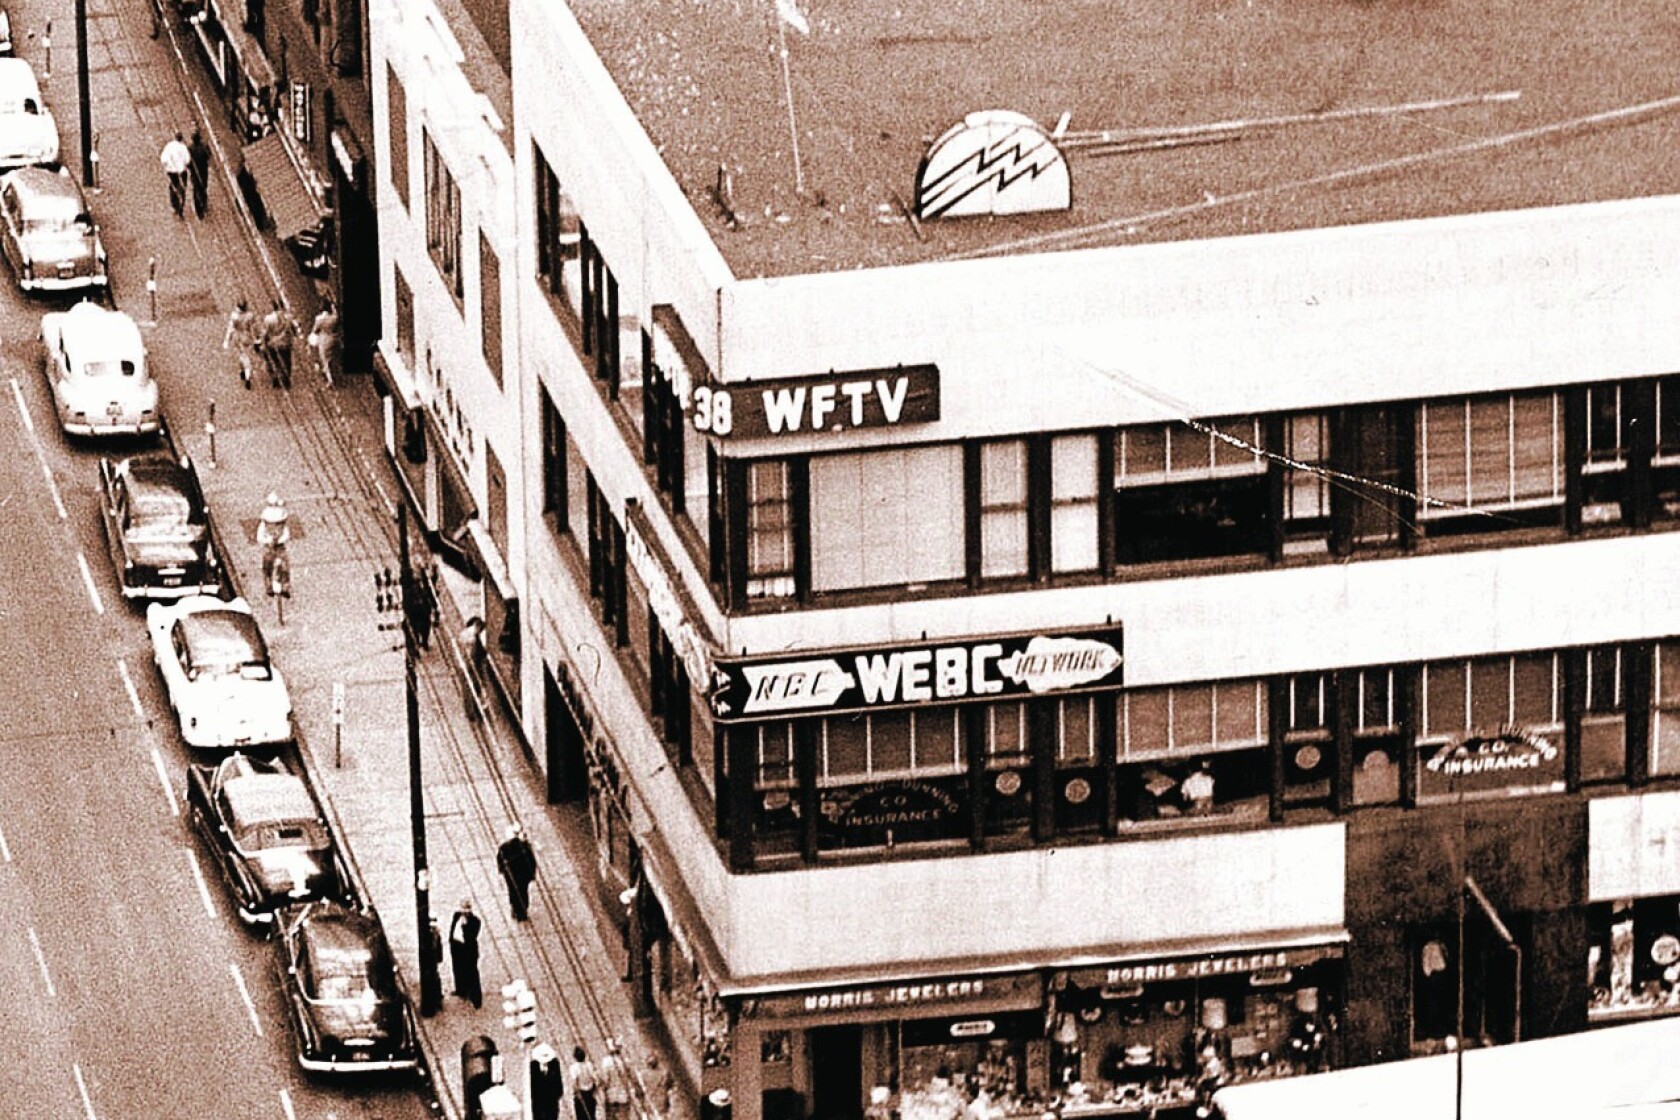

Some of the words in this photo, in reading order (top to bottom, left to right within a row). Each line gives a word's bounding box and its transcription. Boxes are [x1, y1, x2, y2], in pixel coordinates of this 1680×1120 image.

[693, 386, 732, 435] 38
[762, 377, 909, 434] WFTV
[755, 668, 834, 701] NBC
[854, 643, 1004, 704] WEBC
[1443, 752, 1540, 775] INSURANCE
[845, 807, 942, 827] INSURANCE
[1186, 952, 1287, 976] JEWELERS
[884, 979, 984, 1003] JEWELERS
